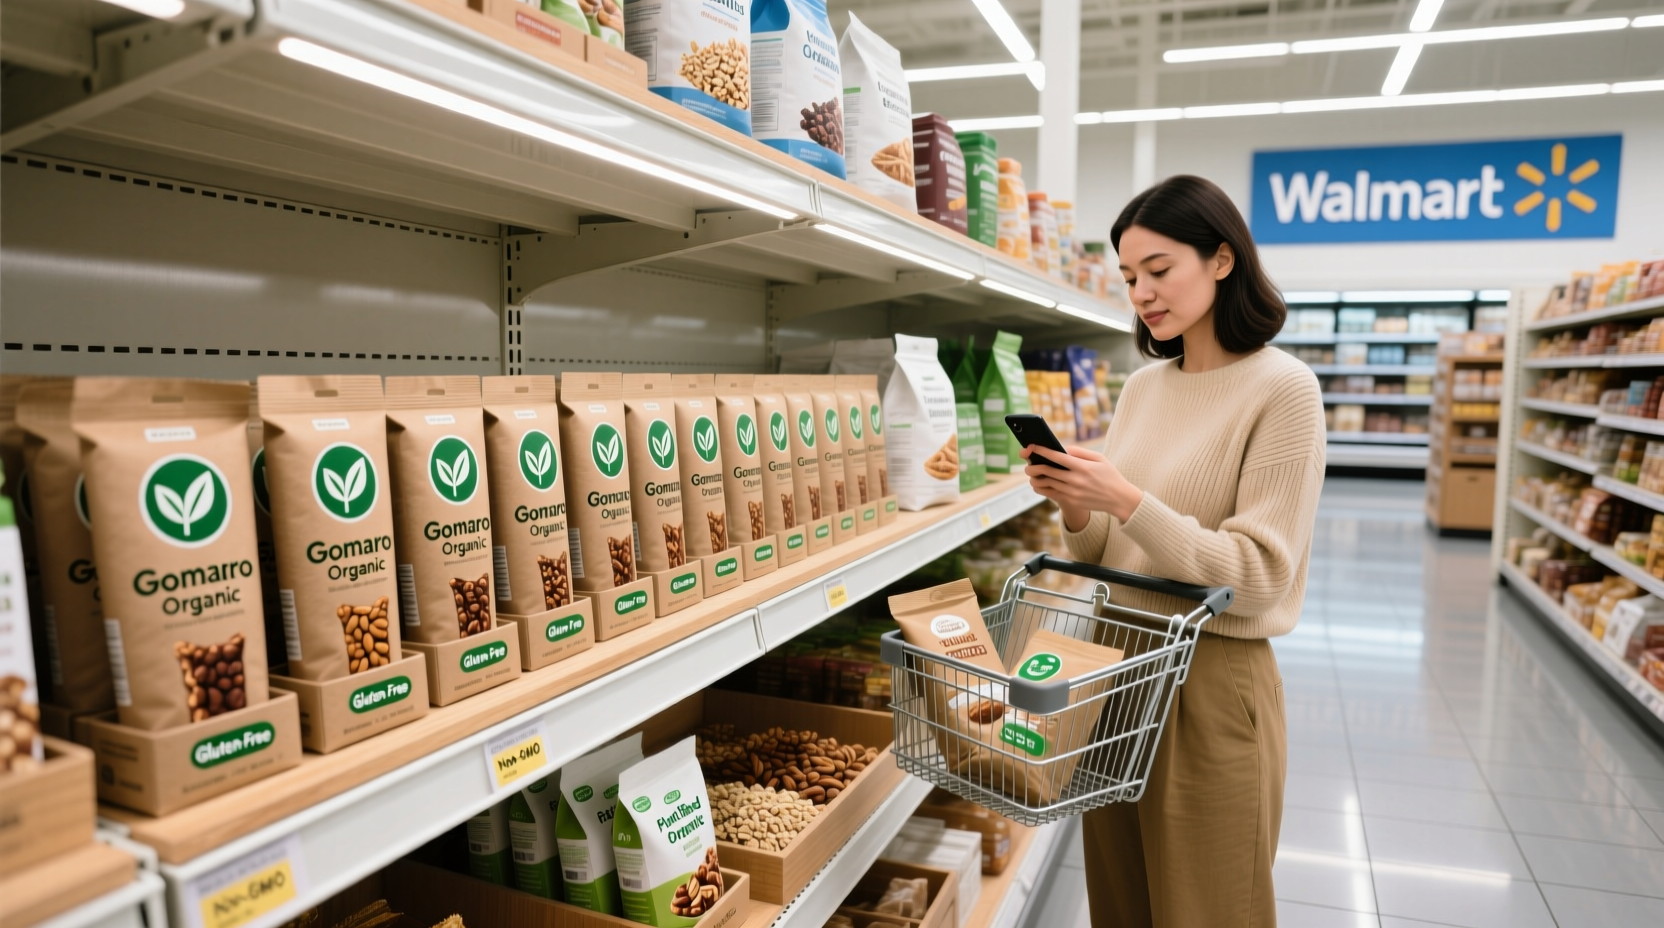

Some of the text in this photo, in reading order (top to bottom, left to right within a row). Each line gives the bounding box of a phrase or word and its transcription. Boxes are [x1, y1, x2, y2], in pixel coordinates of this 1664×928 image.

[1269, 165, 1505, 224] Walmart
[424, 517, 490, 541] Gomaro
[306, 535, 391, 564] Gomaro
[442, 536, 487, 557] Organic
[133, 560, 253, 596] Gomarro
[328, 557, 386, 582] Organic
[162, 586, 241, 616] Organic
[387, 682, 409, 697] Free
[194, 729, 272, 764] Gluten Free
